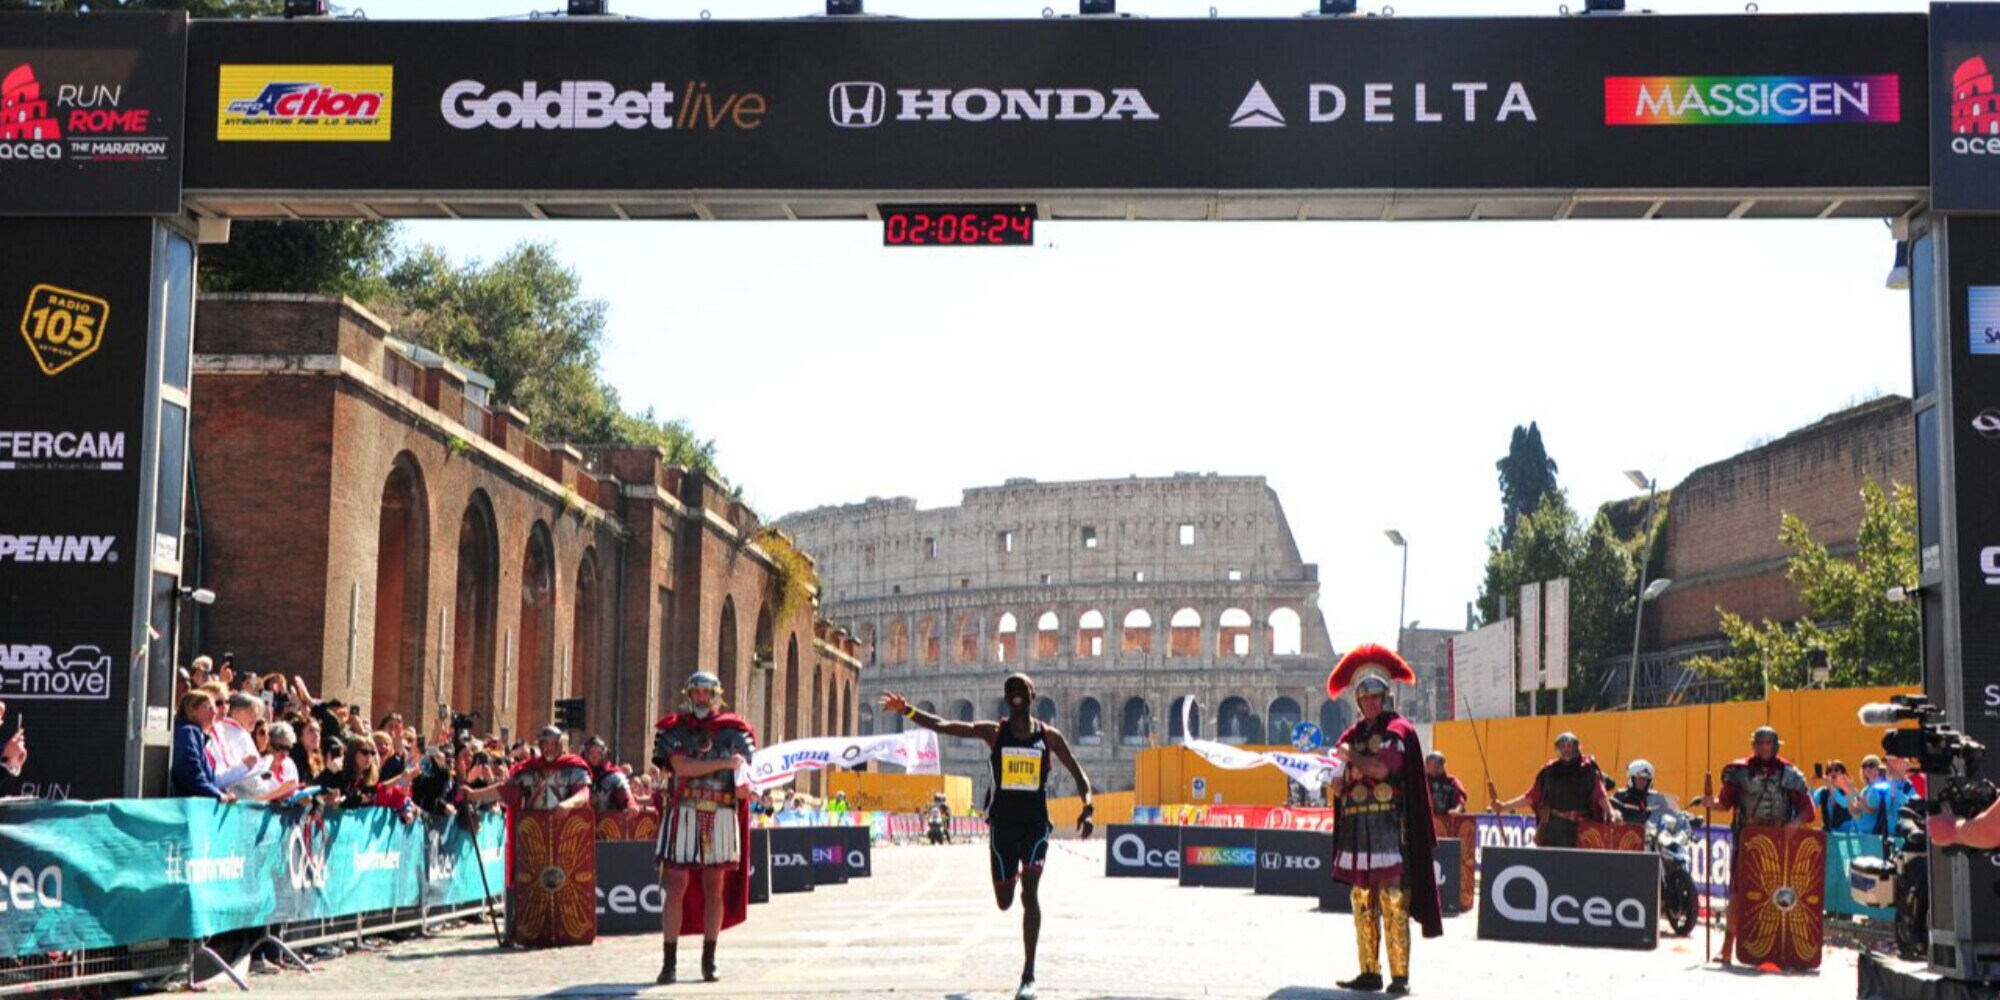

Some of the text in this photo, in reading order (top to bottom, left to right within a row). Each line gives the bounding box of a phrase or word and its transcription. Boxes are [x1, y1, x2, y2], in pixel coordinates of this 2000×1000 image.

[57, 84, 121, 107] RUN
[440, 79, 766, 130] GoldBet live
[896, 88, 1159, 121] HONDA
[1309, 82, 1537, 122] DELTA
[1635, 82, 1869, 117] MASSIGEN
[68, 110, 149, 132] ROME
[71, 142, 165, 154] THE MARATHON
[886, 214, 1032, 243] 02:06:24
[48, 295, 90, 313] RADIO
[33, 307, 95, 349] 105
[0, 431, 124, 459] FERCAM
[0, 671, 104, 693] -move
